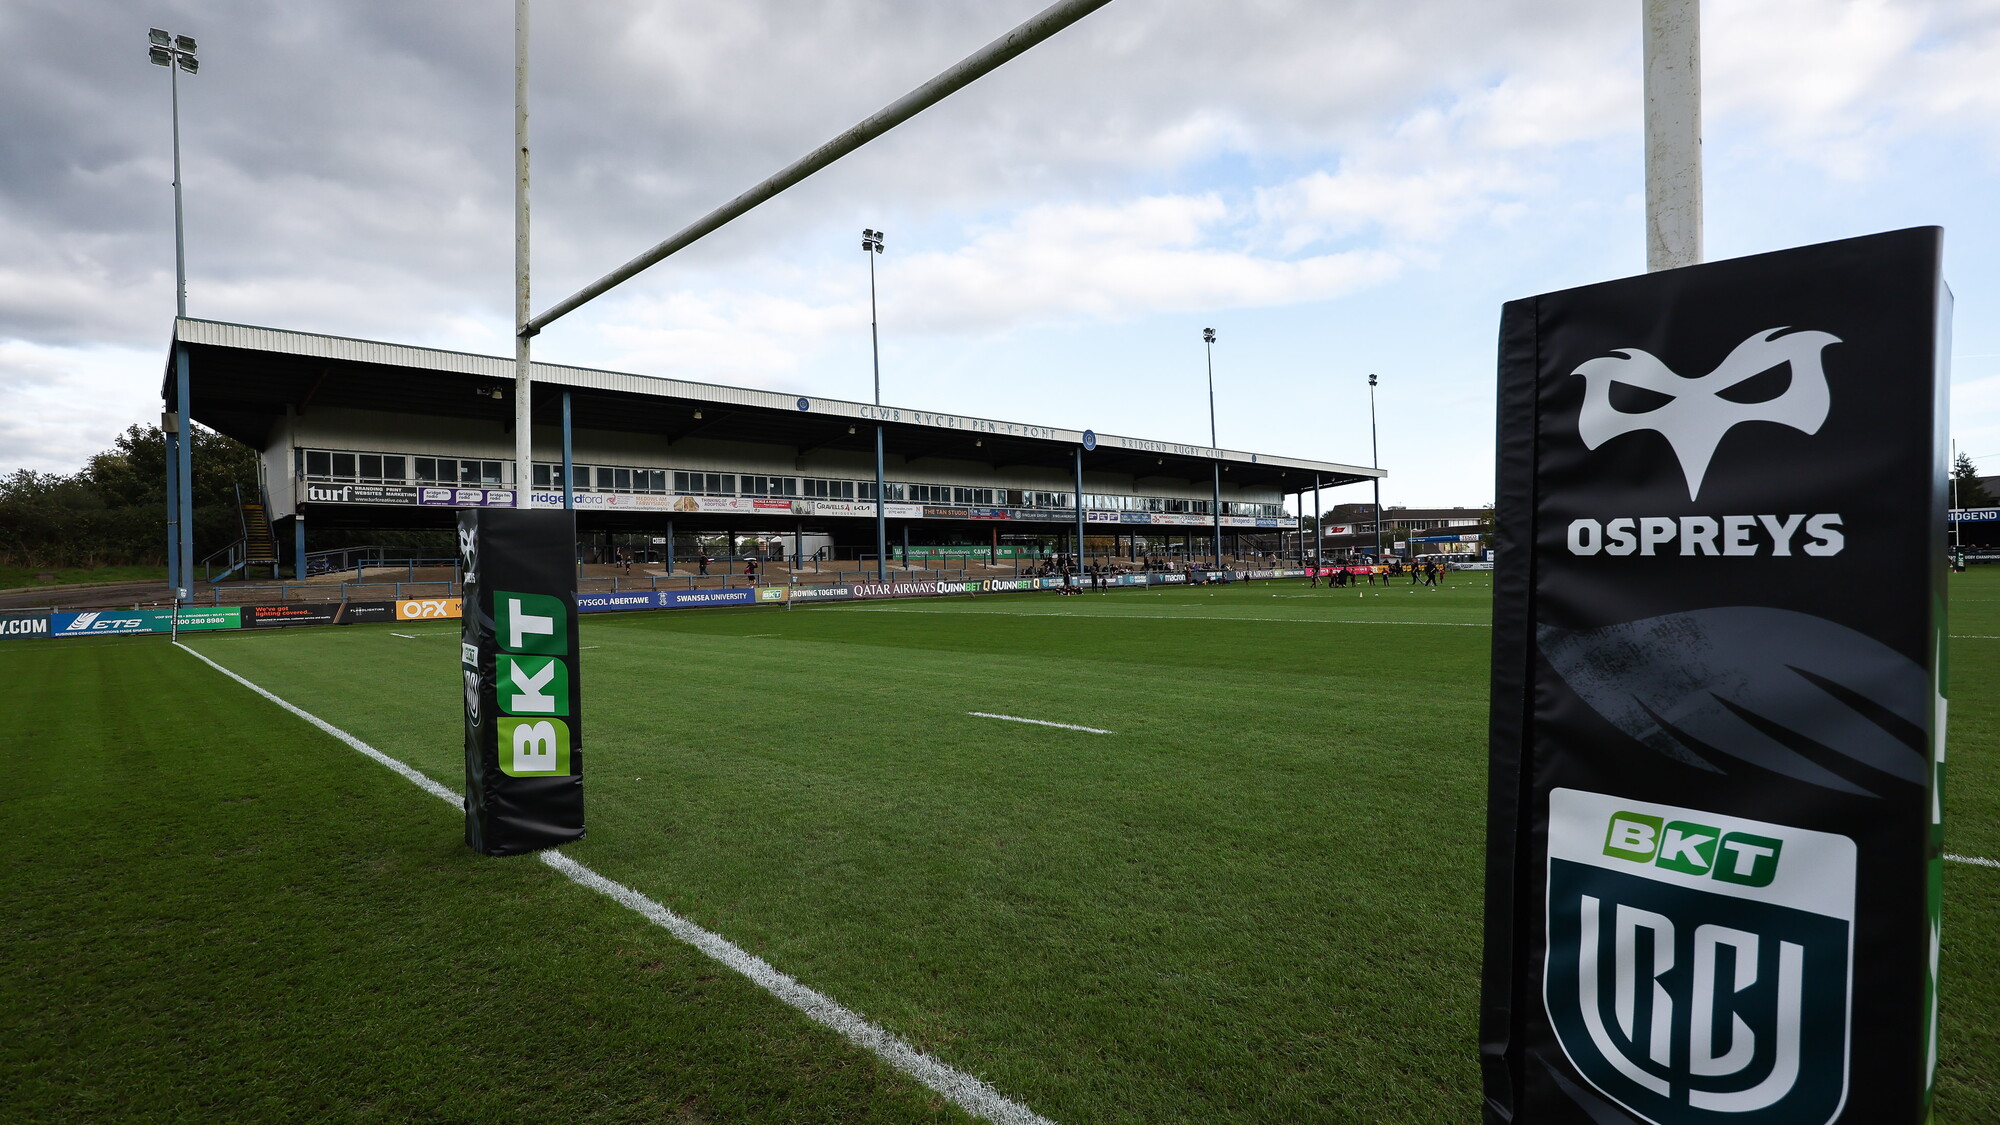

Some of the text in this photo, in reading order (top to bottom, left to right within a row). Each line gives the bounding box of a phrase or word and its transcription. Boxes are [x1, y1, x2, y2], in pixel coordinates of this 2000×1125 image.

[860, 406, 900, 421] CLWB
[1122, 438, 1224, 458] BRIDGEND RUGBY CLUB
[308, 486, 352, 501] turf
[531, 493, 602, 504] ridgedford
[1567, 513, 1844, 557] OSPREYS
[1236, 571, 1252, 579] QATR
[854, 582, 936, 596] QATAR AIRWAYS
[937, 582, 981, 593] QUINNBET
[992, 579, 1031, 592] QUINNBET
[609, 597, 649, 605] ABERTAWE
[711, 593, 747, 601] UNIVERSITY
[763, 590, 782, 599] BKT
[403, 601, 447, 618] OFX
[0, 619, 47, 634] Y.COM
[92, 618, 142, 630] ETS
[509, 598, 556, 772] BKT
[1607, 817, 1777, 879] BKT
